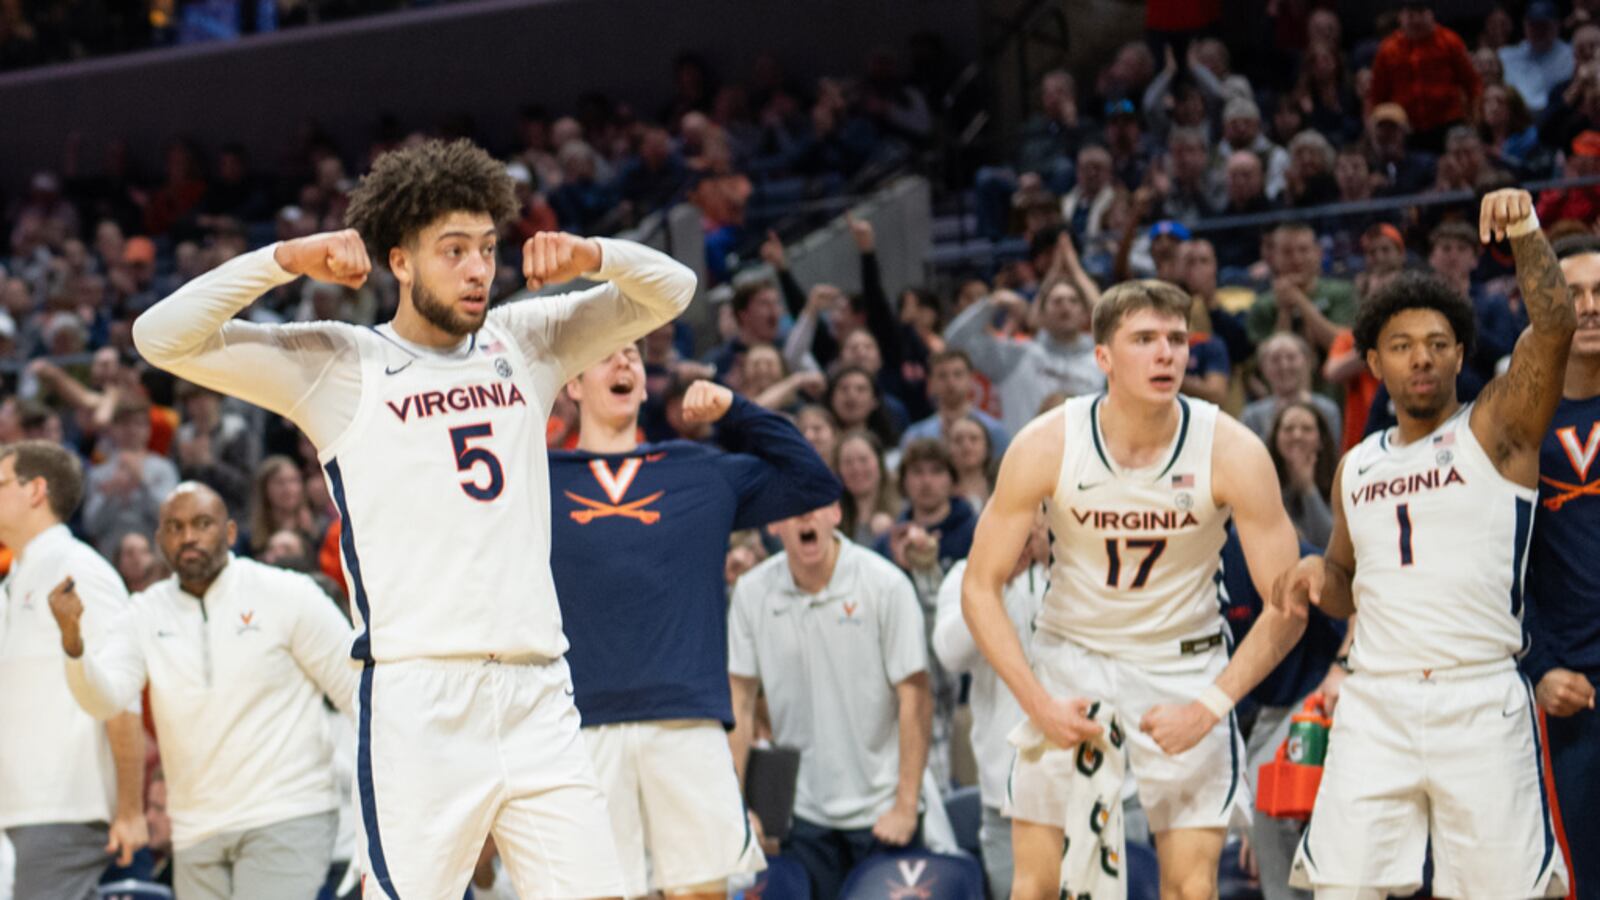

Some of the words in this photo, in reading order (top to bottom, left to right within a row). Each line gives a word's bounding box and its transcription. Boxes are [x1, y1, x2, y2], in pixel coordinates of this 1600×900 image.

[386, 383, 527, 423] VIRGINIA
[448, 421, 505, 502] 5
[587, 457, 644, 505] V
[1351, 465, 1467, 507] VIRGINIA
[1070, 506, 1199, 531] VIRGINIA
[1396, 502, 1414, 567] 1
[1104, 536, 1168, 591] 17
